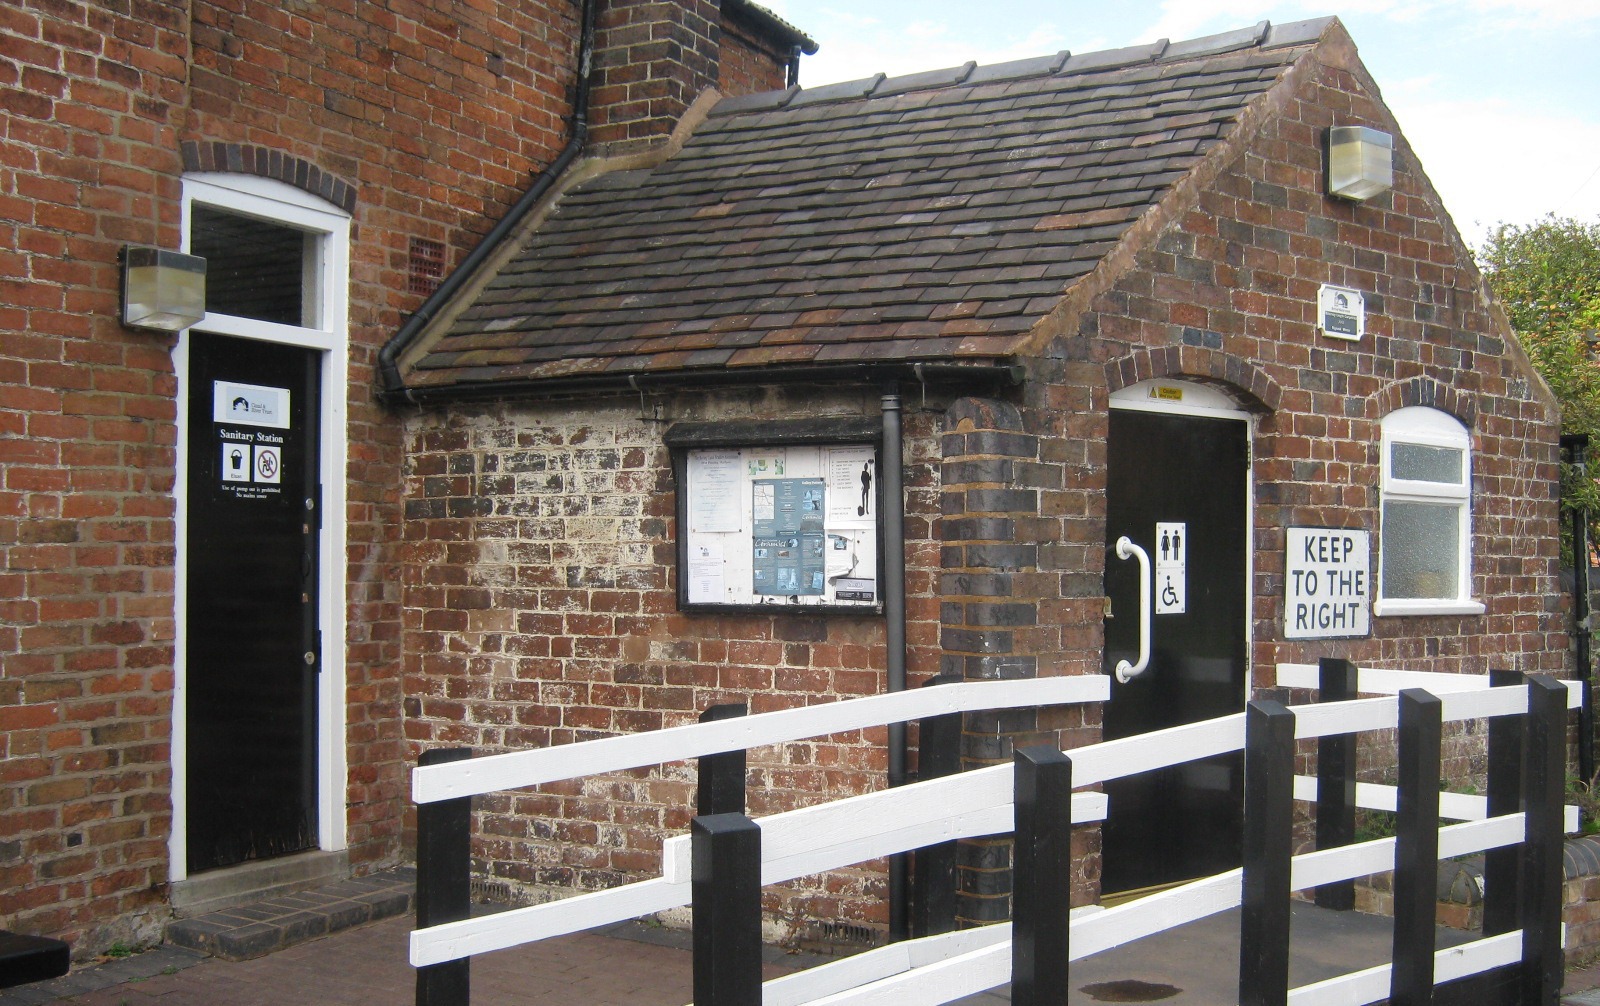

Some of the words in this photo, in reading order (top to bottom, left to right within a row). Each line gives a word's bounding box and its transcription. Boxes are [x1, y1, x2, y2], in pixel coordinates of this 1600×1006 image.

[220, 428, 254, 442] Sanitary
[257, 431, 284, 444] Station
[1304, 535, 1353, 563] KEEP
[1291, 569, 1318, 596] TO
[1326, 569, 1365, 596] THE
[1295, 602, 1360, 630] RIGHT
